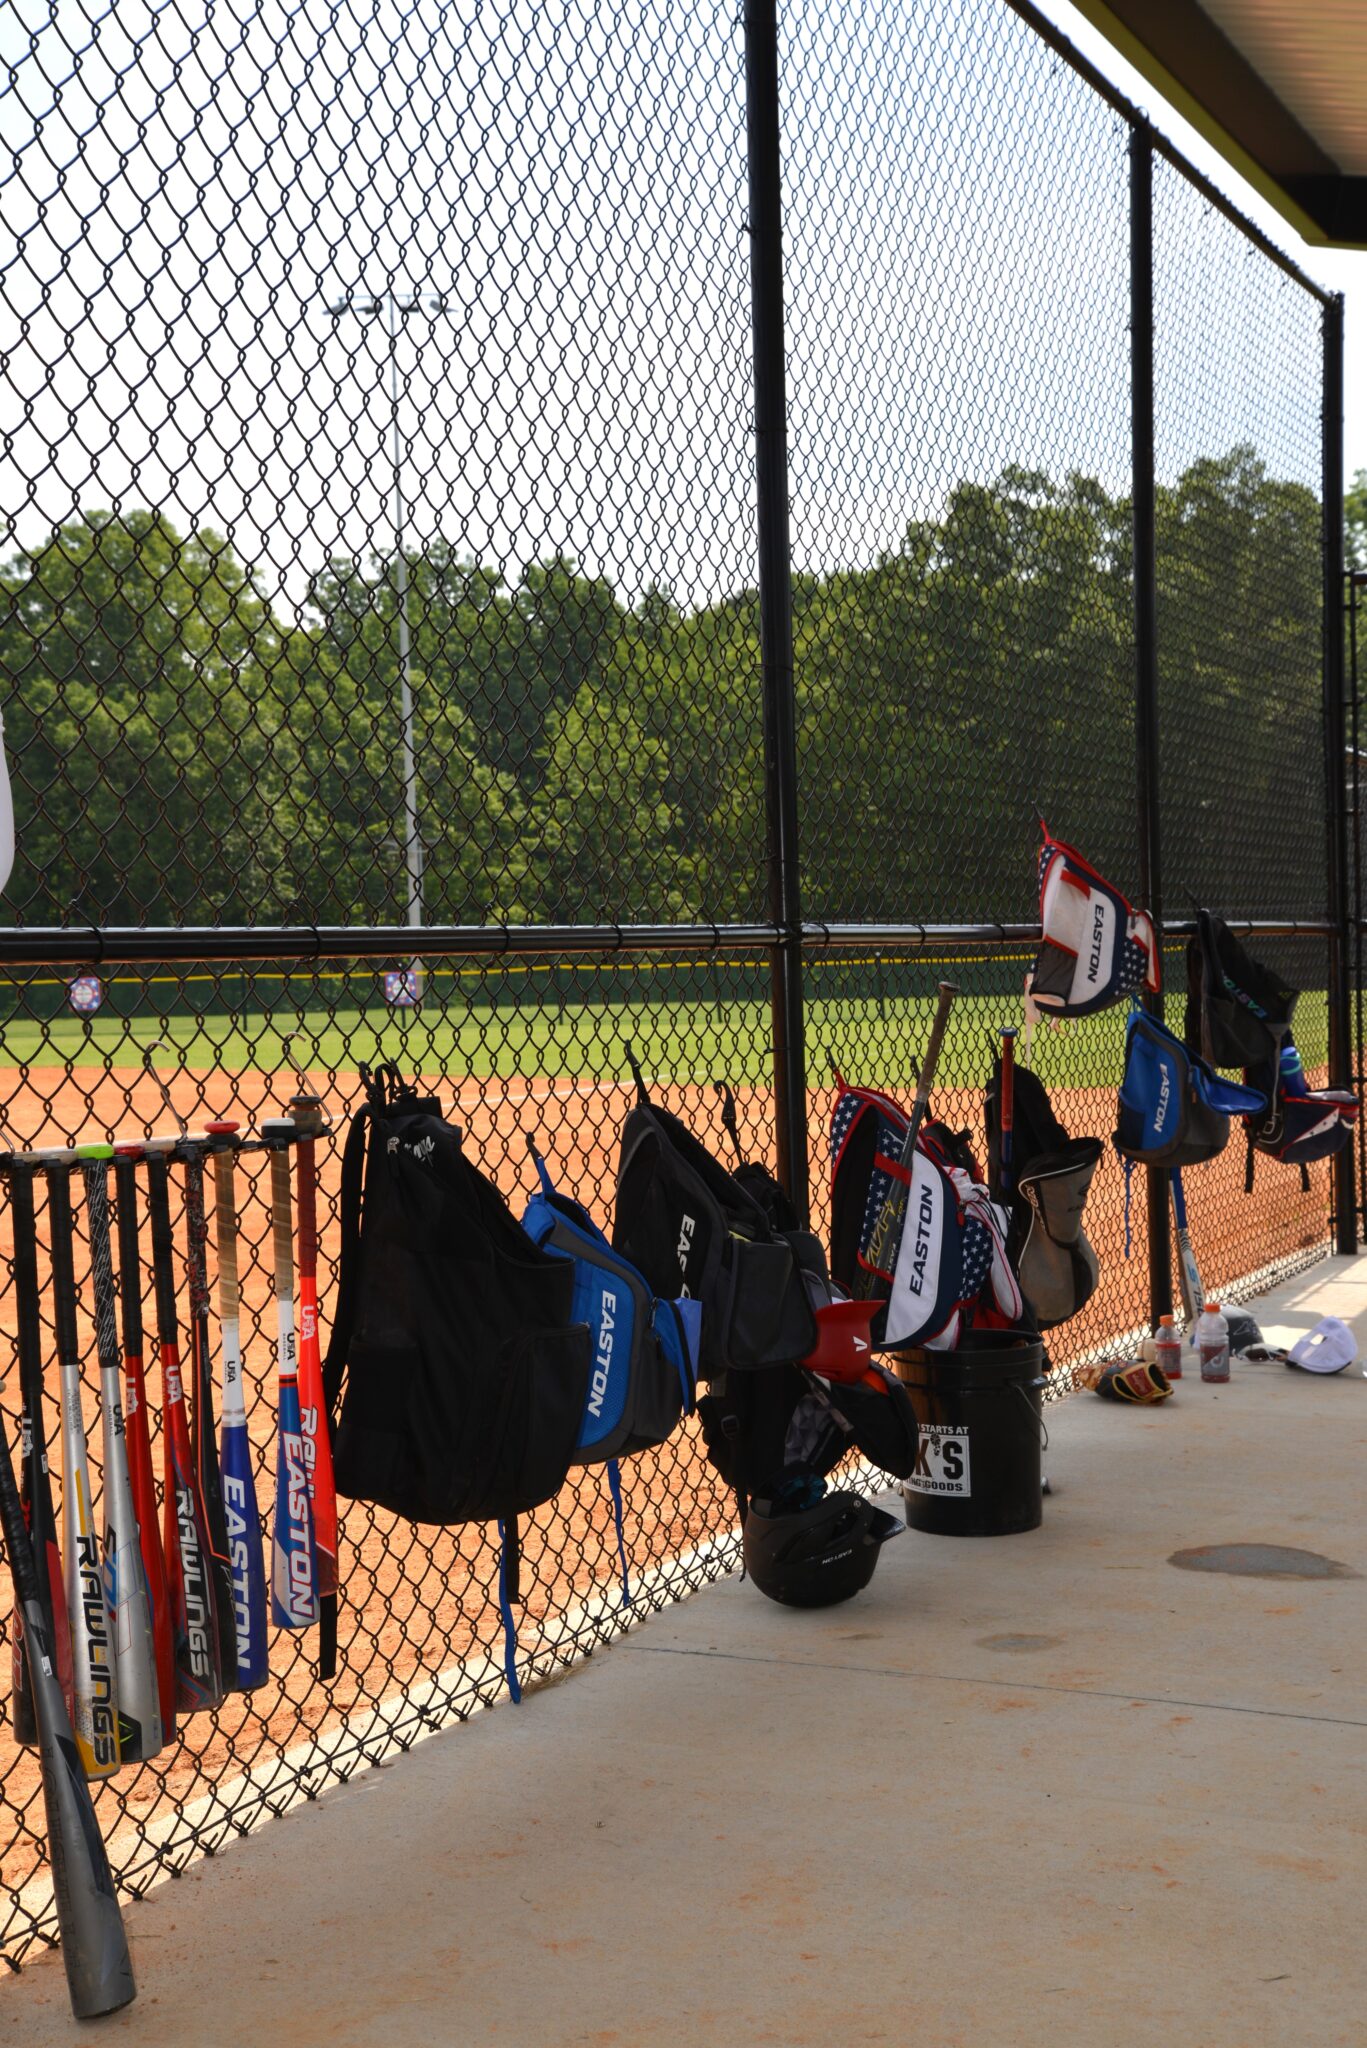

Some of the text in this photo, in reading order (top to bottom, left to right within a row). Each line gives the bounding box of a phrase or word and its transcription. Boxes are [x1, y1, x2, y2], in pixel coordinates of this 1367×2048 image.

[1087, 904, 1104, 983] EASTON
[1154, 1063, 1169, 1133] EASTON
[909, 1184, 933, 1296] EASTON
[302, 1305, 316, 1341] USA
[587, 1290, 616, 1418] EASTON
[227, 1361, 236, 1383] USA
[915, 1433, 963, 1480] K'S
[921, 1424, 954, 1434] STARTS
[956, 1426, 969, 1434] AT
[224, 1474, 250, 1669] EASTON
[283, 1432, 314, 1618] EASTON
[176, 1487, 209, 1677] RAWLINGS
[76, 1533, 116, 1766] RAWLINGS
